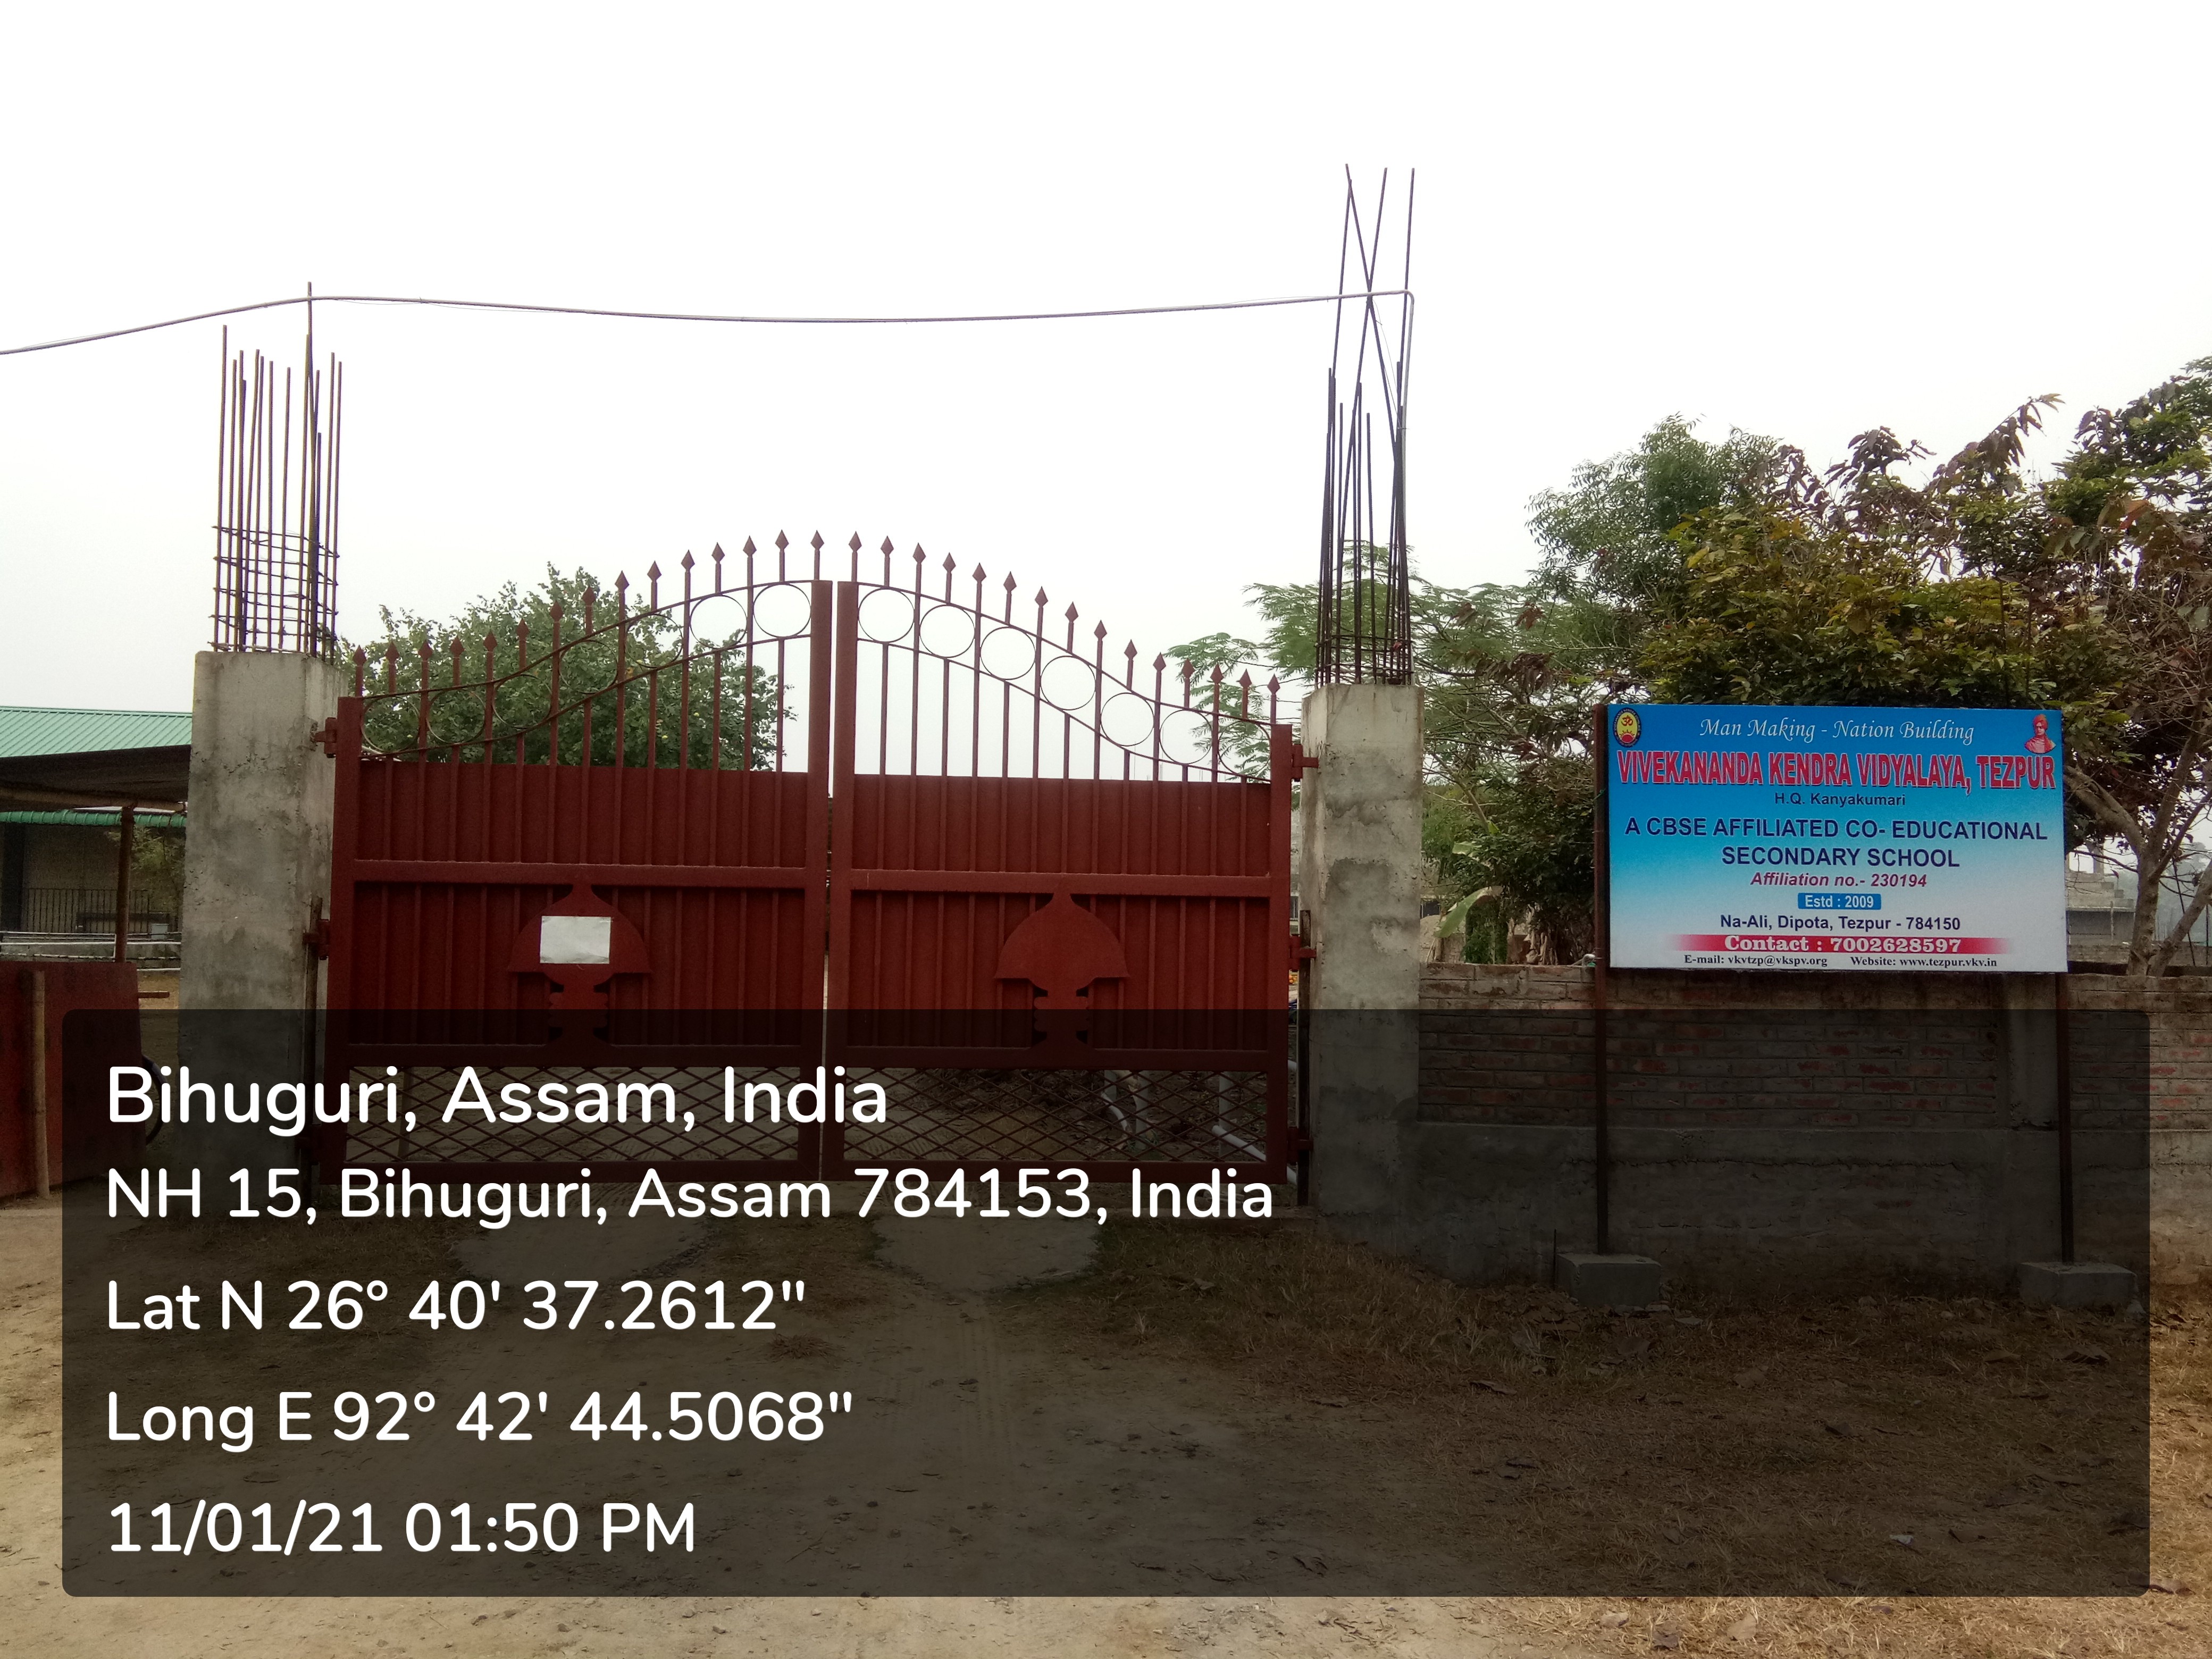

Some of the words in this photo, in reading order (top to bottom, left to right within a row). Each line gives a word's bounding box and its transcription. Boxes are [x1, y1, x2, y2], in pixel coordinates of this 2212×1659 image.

[1700, 719, 1741, 736] Man
[1747, 717, 1815, 743] Making
[1833, 720, 1894, 738] Nation
[1900, 719, 1974, 745] Building
[1617, 750, 1763, 785] VIVEKANANDA
[1768, 752, 1852, 786] KENDRA
[1856, 753, 1971, 795] VIDYALAYA,
[1975, 756, 2056, 789] TEZPUR
[1775, 792, 1805, 805] H.Q.
[1811, 793, 1905, 808] Kanyakumari
[1624, 817, 1641, 835] A
[1647, 817, 1706, 836] CBSE
[1712, 818, 1838, 838] AFFILIATED
[1892, 820, 2048, 840] EDUCATIONAL
[1722, 847, 1861, 866] SECONDARY
[1867, 848, 1960, 867] SCHOOL
[1750, 872, 1829, 886] Affiliation
[1871, 874, 1927, 887] 230194
[1805, 895, 1833, 908] Estd
[1845, 895, 1874, 908] 2009
[1720, 915, 1772, 930] Na-Ali,
[1778, 915, 1833, 931] Dipota,
[1838, 916, 1891, 932] Tezpur
[1906, 917, 1960, 930] 784150
[1724, 935, 1808, 951] Contact
[1830, 937, 1961, 952] 7002628597
[1684, 954, 1724, 964] E-mail:
[1728, 955, 1828, 967] vkvtzp@vkspv.org
[1850, 956, 1896, 966] Website:
[1900, 957, 1997, 968] www.tezpur.vkv.in
